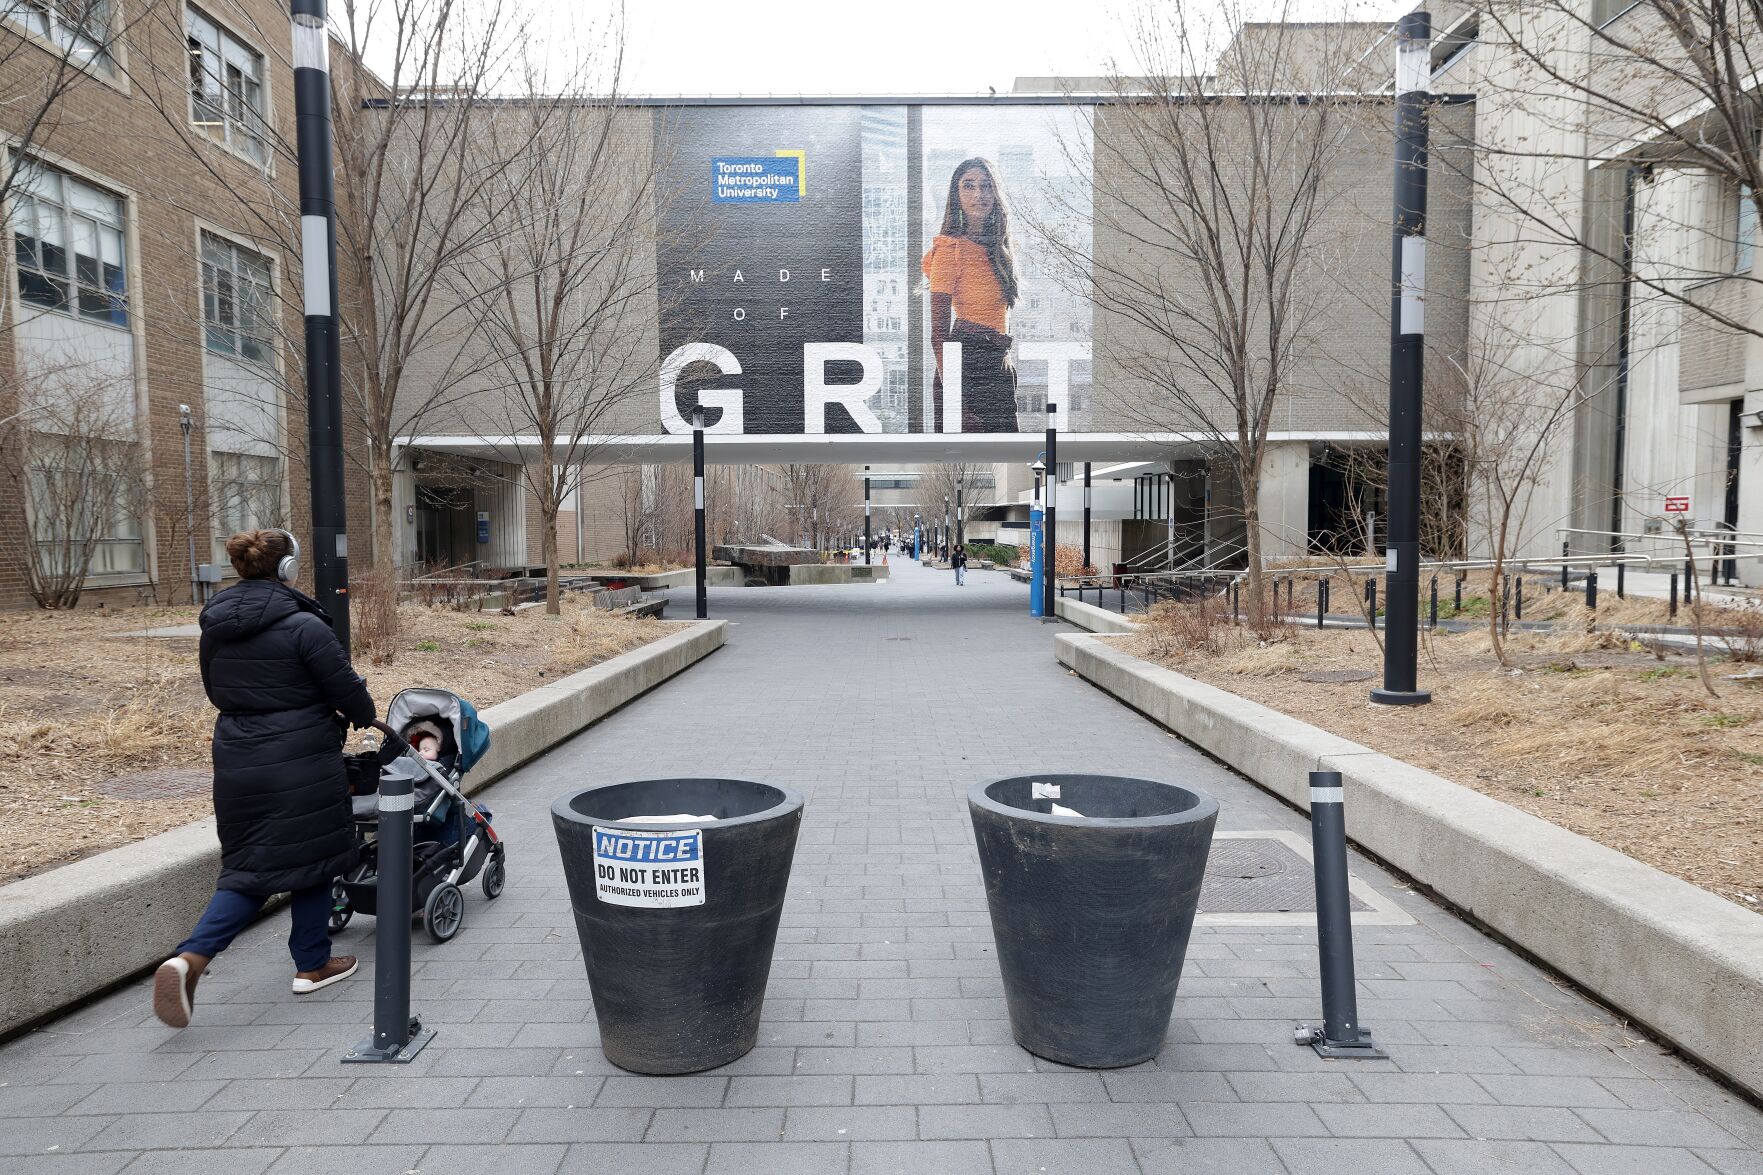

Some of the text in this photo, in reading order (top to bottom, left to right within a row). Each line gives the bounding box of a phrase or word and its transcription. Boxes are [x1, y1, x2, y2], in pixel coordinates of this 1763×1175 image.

[717, 162, 763, 173] Toronto
[718, 174, 794, 187] Metropolitan
[718, 187, 778, 199] University
[690, 268, 831, 283] MADE
[733, 307, 789, 321] OF
[660, 342, 1092, 434] GRIT
[600, 836, 694, 860] NOTICE
[598, 864, 700, 884] DO NOT ENTER
[599, 884, 700, 898] AUTHORIZED VEHICLES ONLY
